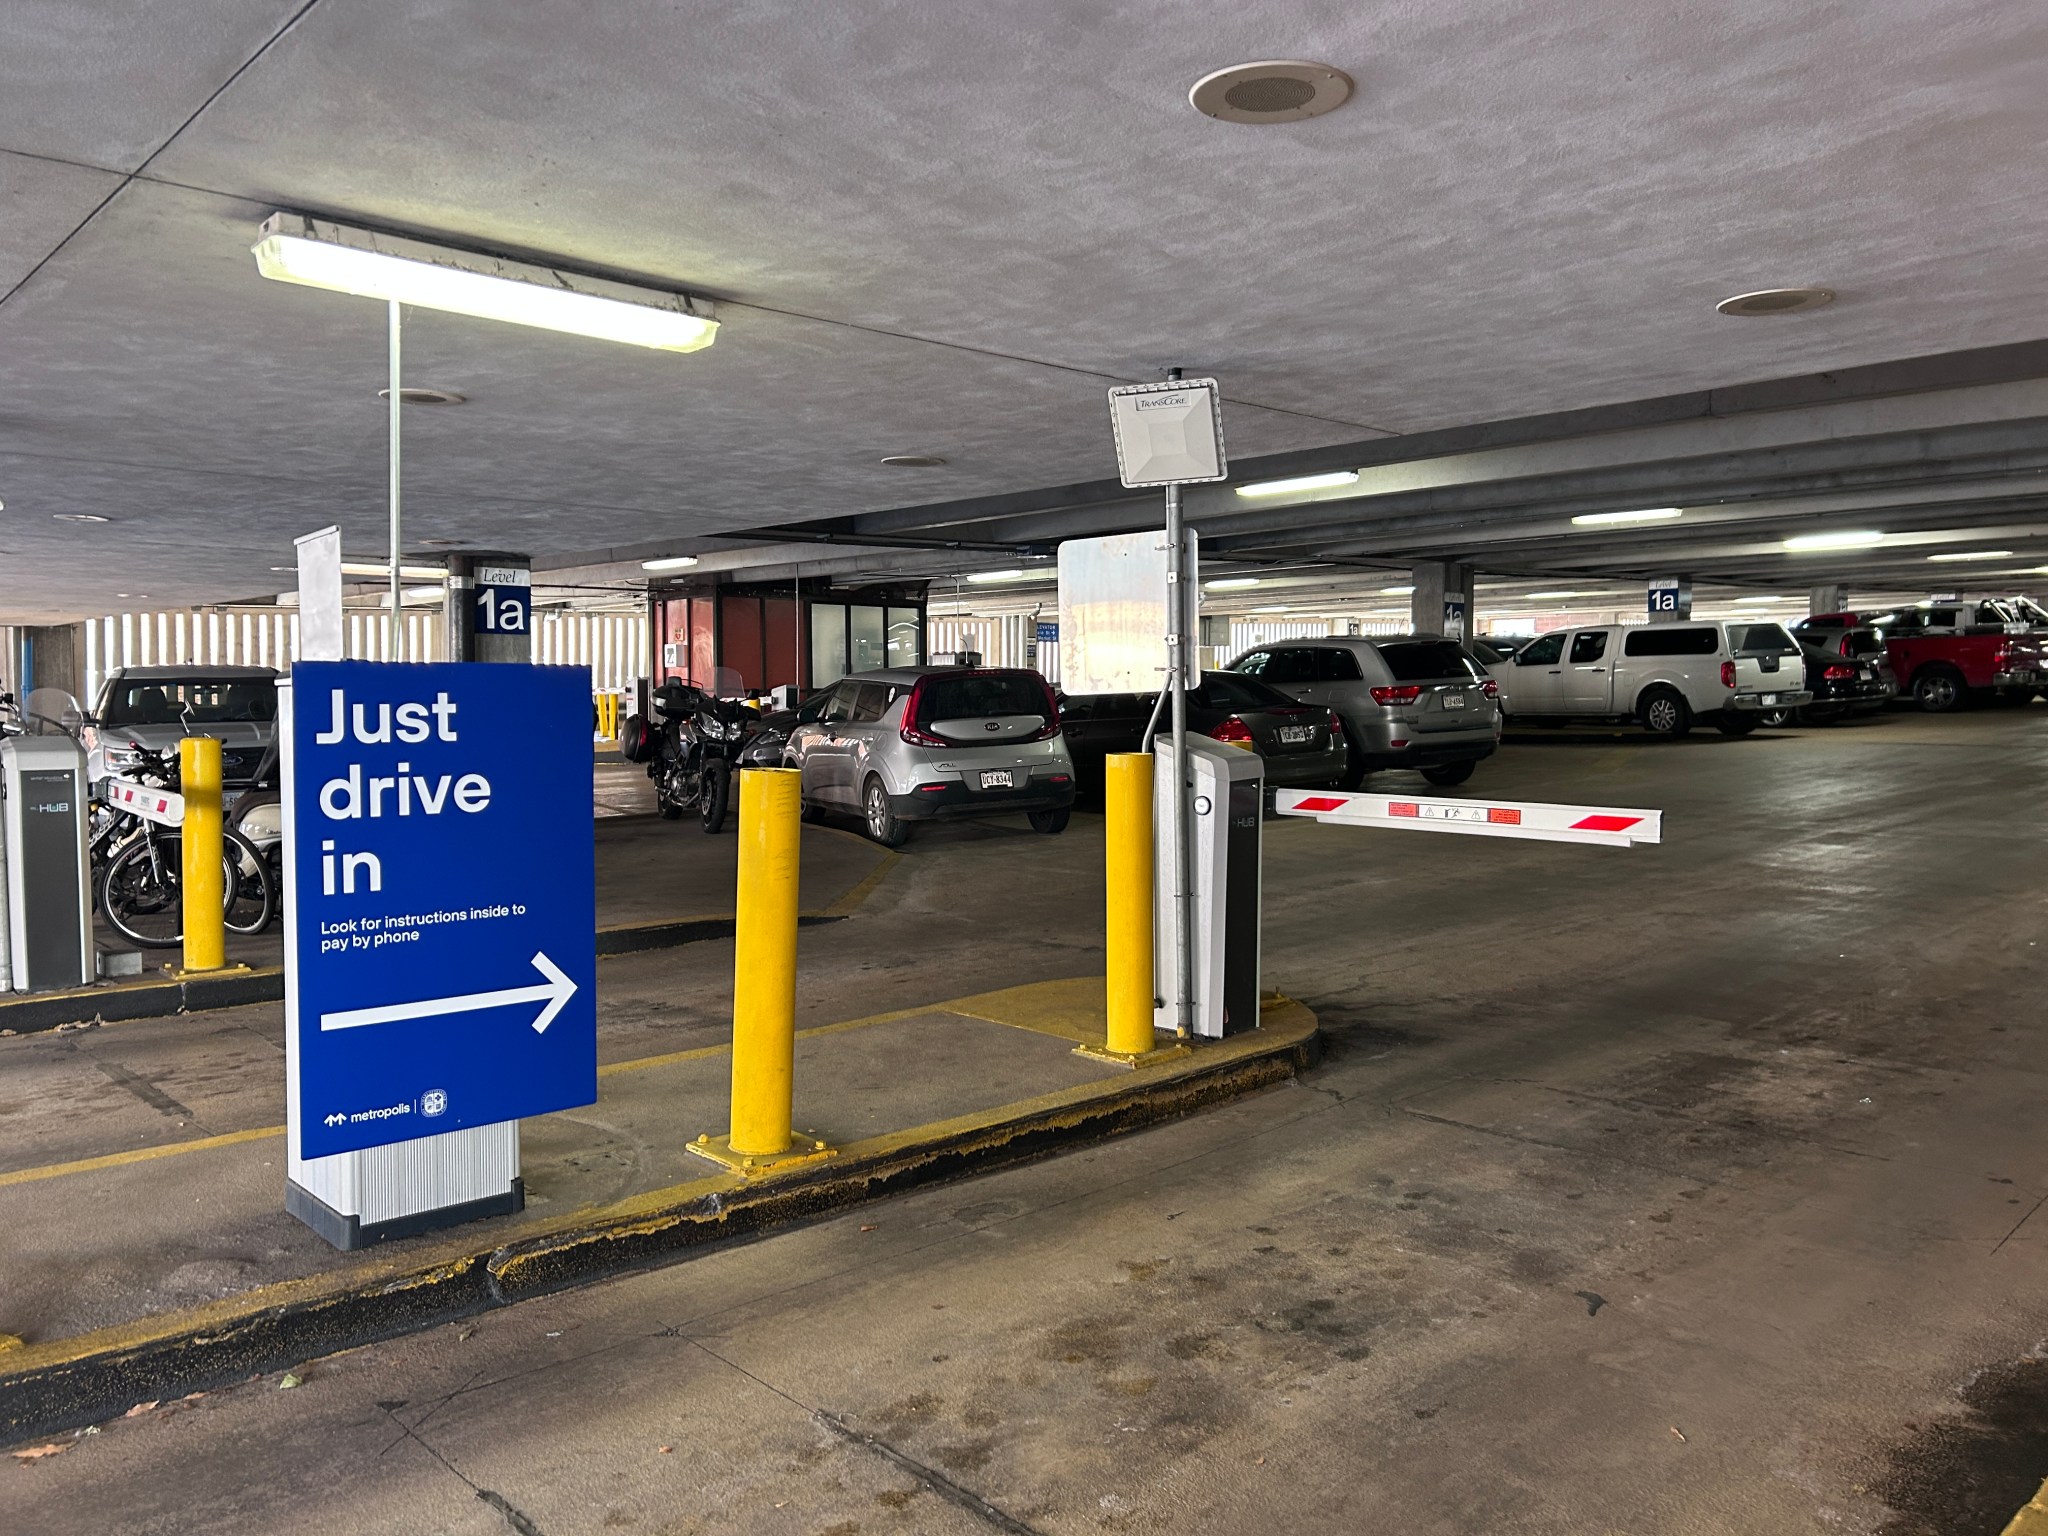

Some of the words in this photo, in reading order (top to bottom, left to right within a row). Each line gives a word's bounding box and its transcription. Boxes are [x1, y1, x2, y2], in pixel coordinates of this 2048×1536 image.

[484, 569, 516, 583] Level
[478, 588, 524, 630] 1a
[1652, 590, 1674, 610] 1a
[316, 689, 457, 744] Just
[319, 762, 491, 820] drive
[39, 803, 69, 813] HUB
[1237, 817, 1255, 827] HUB
[322, 839, 382, 896] in
[321, 919, 358, 935] Look
[360, 917, 382, 931] for
[384, 910, 468, 929] instructions
[470, 904, 509, 920] inside
[512, 903, 526, 915] to
[321, 937, 349, 953] pay
[352, 934, 371, 949] by
[374, 930, 420, 947] phone
[350, 1103, 410, 1123] metropolis
